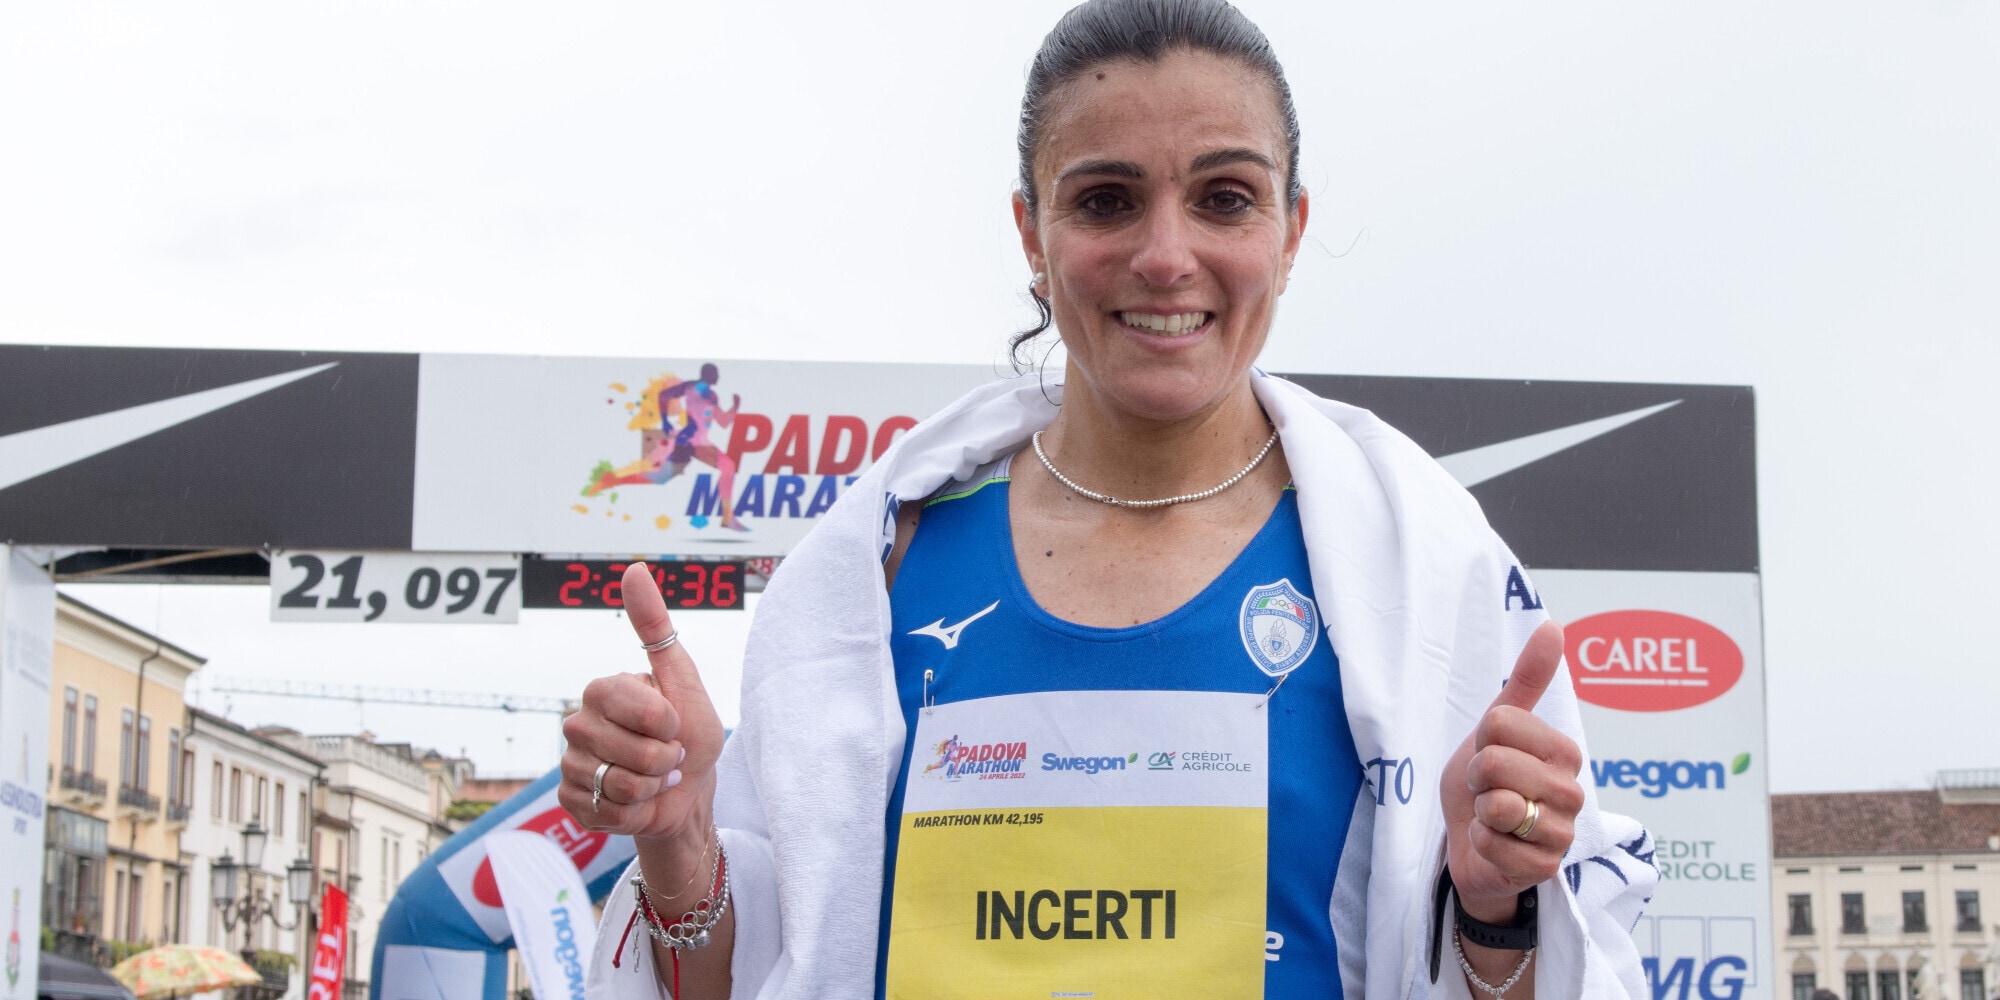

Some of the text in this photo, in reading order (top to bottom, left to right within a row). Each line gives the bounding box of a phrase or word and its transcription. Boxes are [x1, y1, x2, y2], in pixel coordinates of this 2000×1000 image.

[685, 473, 861, 518] MARA
[279, 555, 518, 622] 21, 097
[1578, 637, 1709, 674] CAREL
[956, 742, 1027, 763] PADOVA
[1041, 752, 1126, 775] Swegon
[1182, 751, 1232, 761] CRÉDIT
[946, 759, 1021, 776] MARATHON
[1182, 762, 1252, 772] AGRICOLE
[913, 813, 1043, 828] MARATHON KM 42,195
[975, 889, 1177, 941] INCERTI
